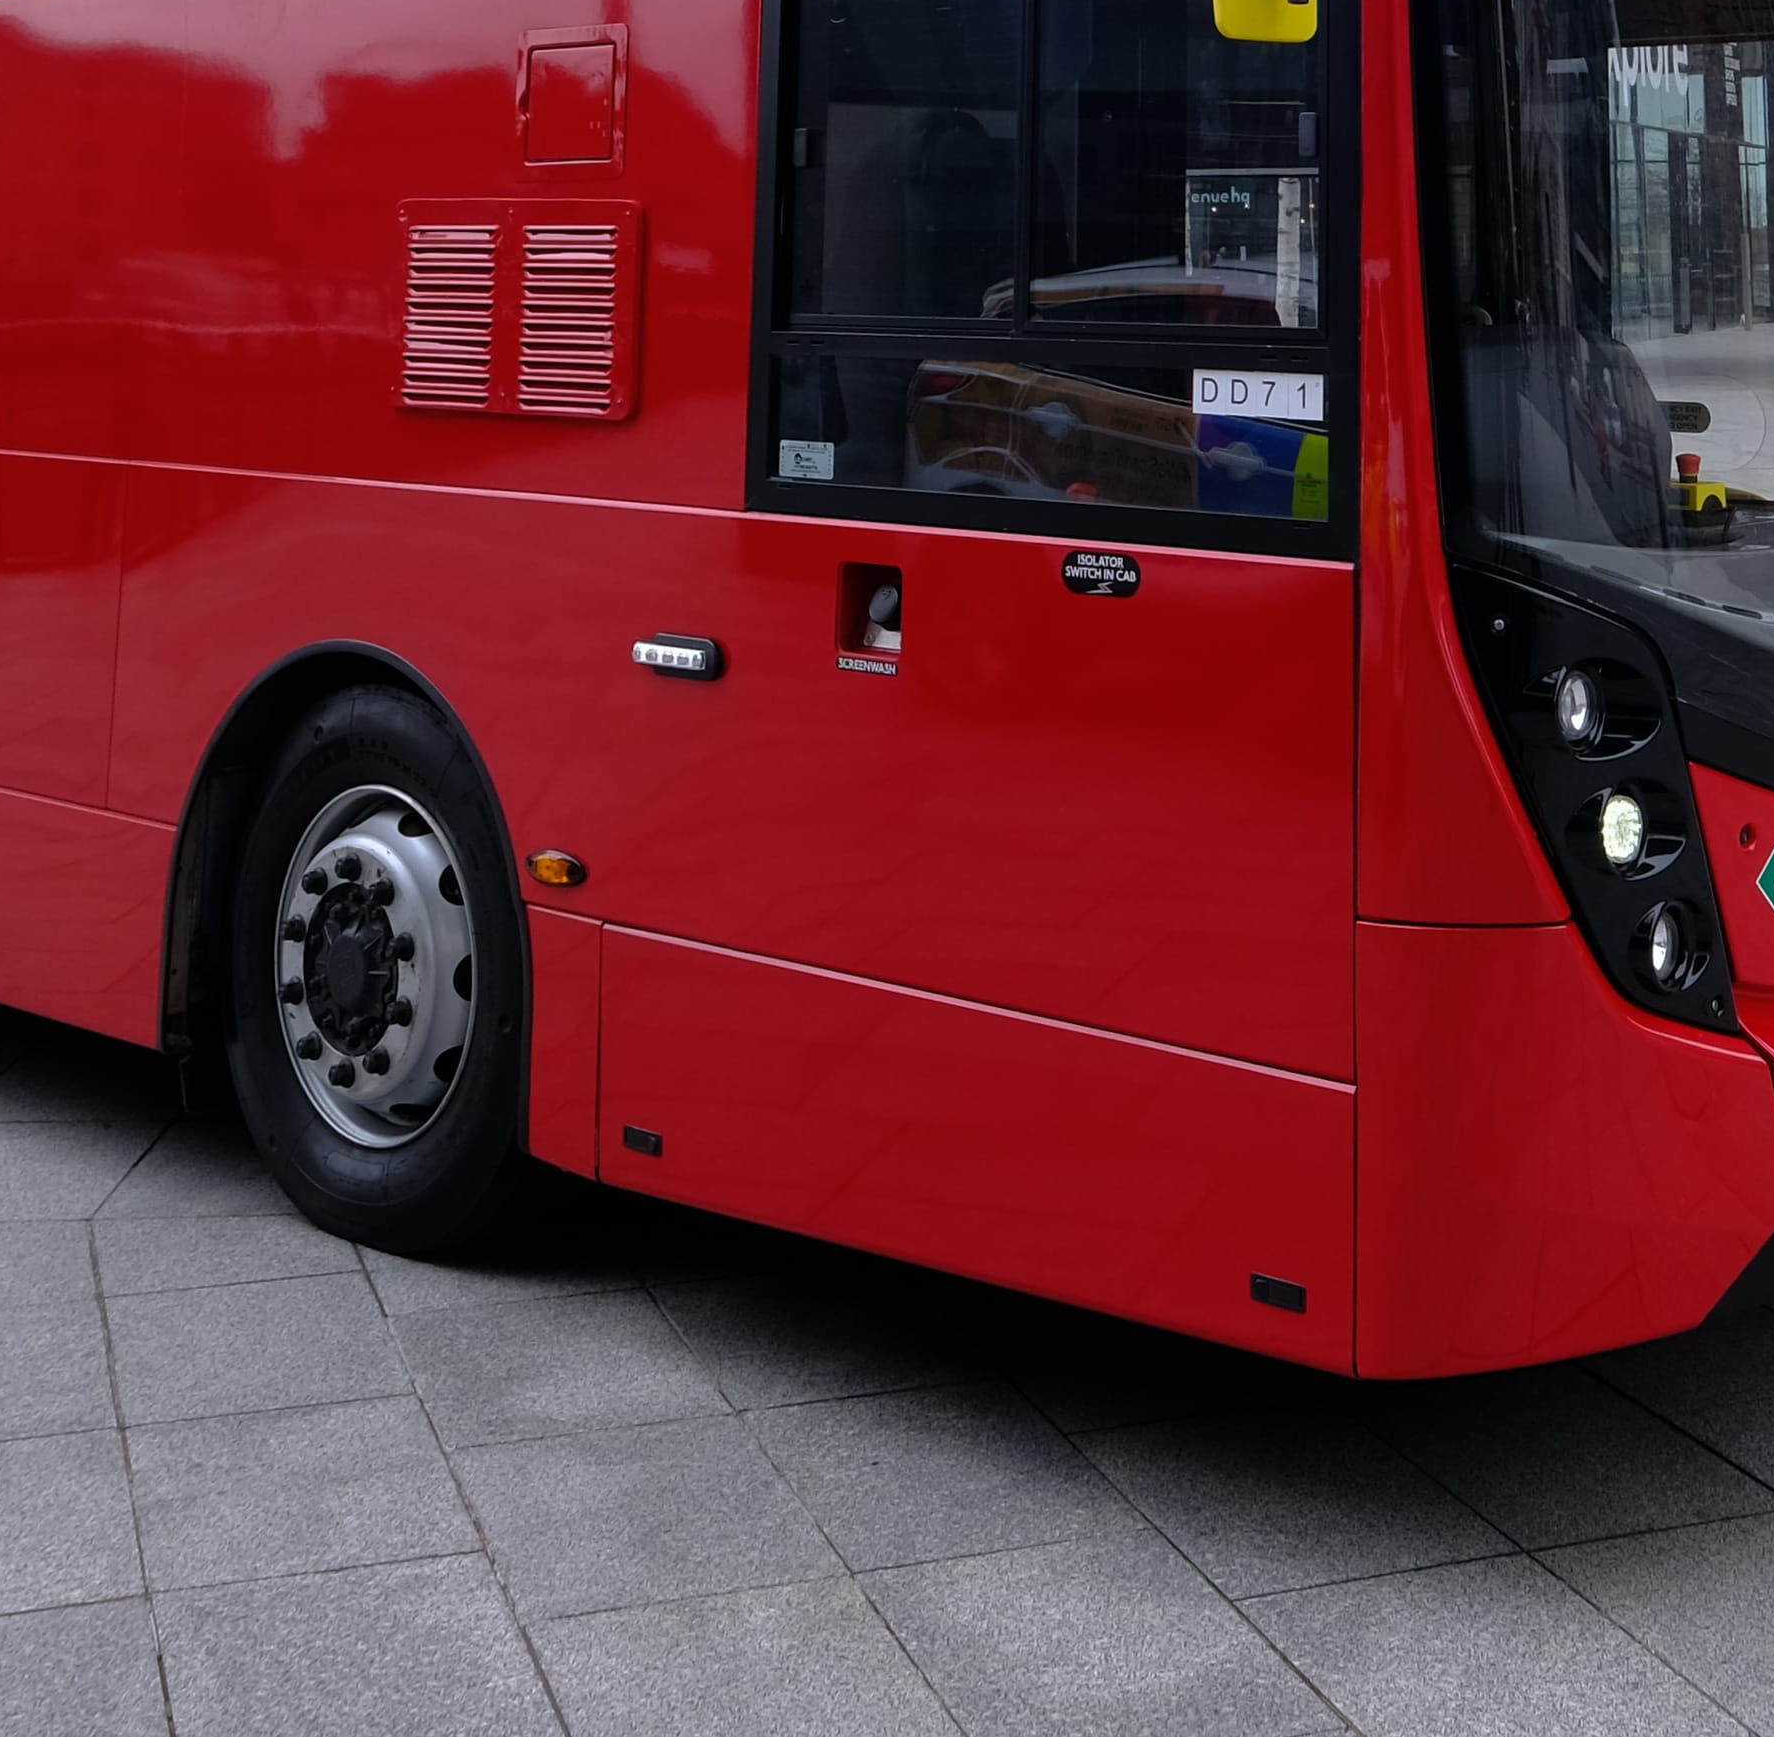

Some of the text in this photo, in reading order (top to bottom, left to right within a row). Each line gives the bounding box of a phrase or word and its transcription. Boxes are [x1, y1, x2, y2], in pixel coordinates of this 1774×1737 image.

[1077, 553, 1124, 568] ISOLATOR
[1065, 565, 1137, 583] SWITCH IN CAB
[838, 657, 896, 675] SCREENWASH
